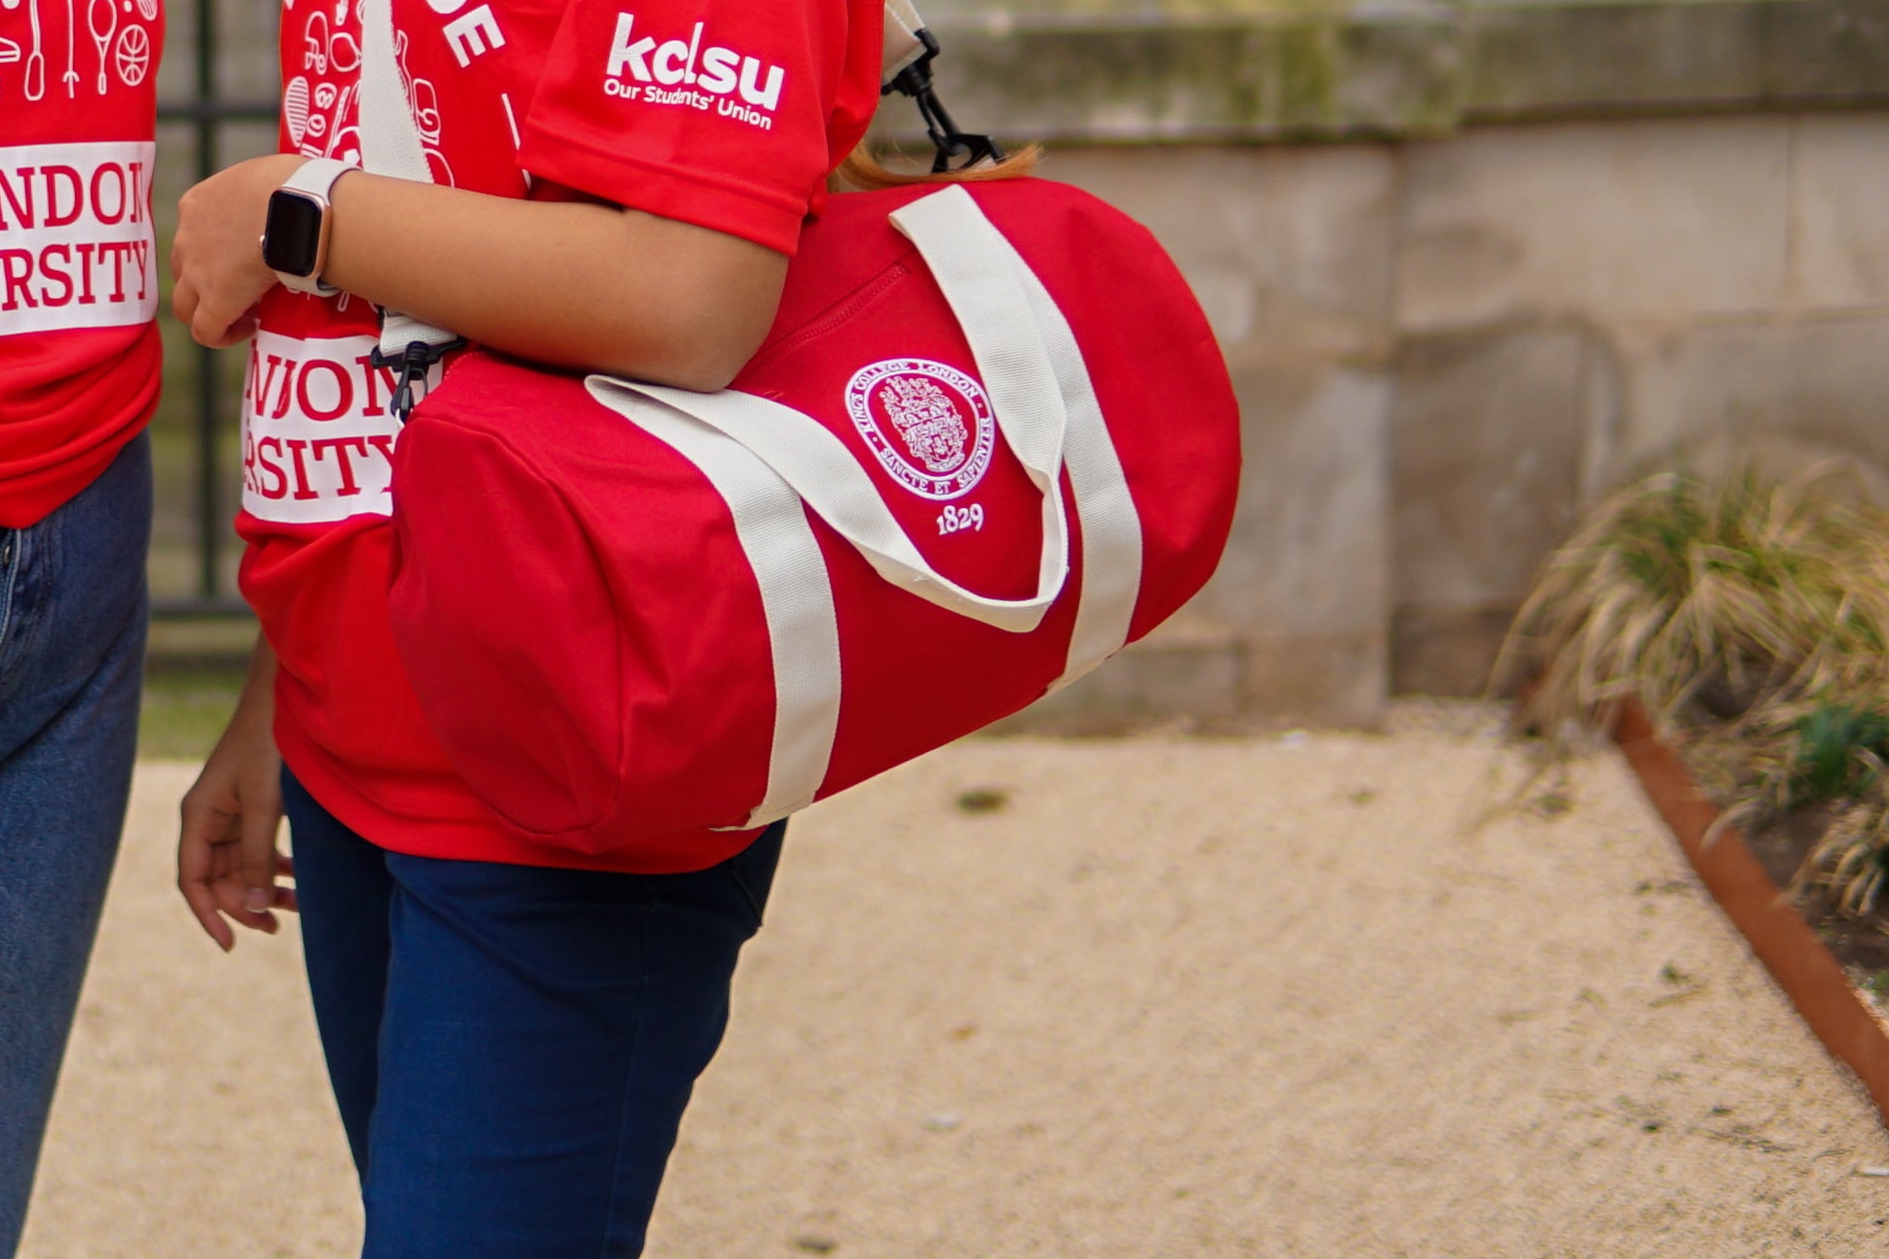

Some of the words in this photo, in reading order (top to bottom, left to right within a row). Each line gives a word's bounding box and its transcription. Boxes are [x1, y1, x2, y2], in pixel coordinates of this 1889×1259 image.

[603, 78, 642, 100] Our
[717, 98, 772, 131] Union
[854, 361, 911, 391] COLLEGE
[916, 362, 979, 399] LONDON
[879, 446, 928, 493] SANCTE
[934, 481, 951, 495] ET
[957, 416, 992, 488] SAPIENTER
[936, 503, 984, 535] 1829
